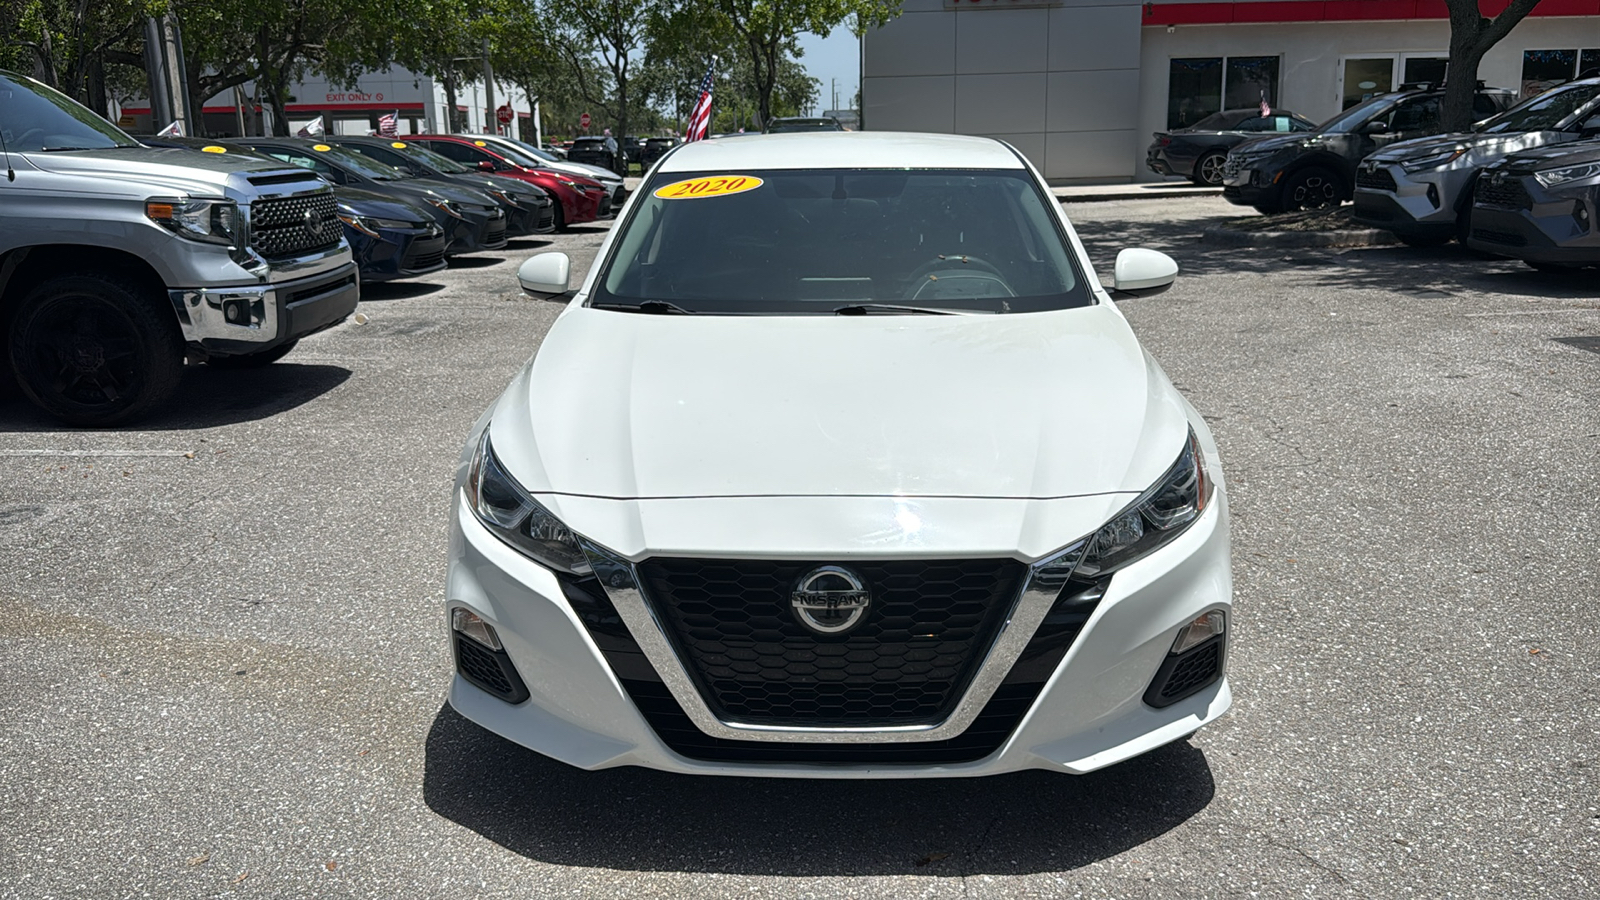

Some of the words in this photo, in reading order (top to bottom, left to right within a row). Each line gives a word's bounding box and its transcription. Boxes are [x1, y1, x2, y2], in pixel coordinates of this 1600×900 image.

[326, 93, 345, 102] EXIT
[348, 93, 372, 102] ONLY
[670, 178, 747, 197] 2020
[800, 594, 861, 605] NISSAN
